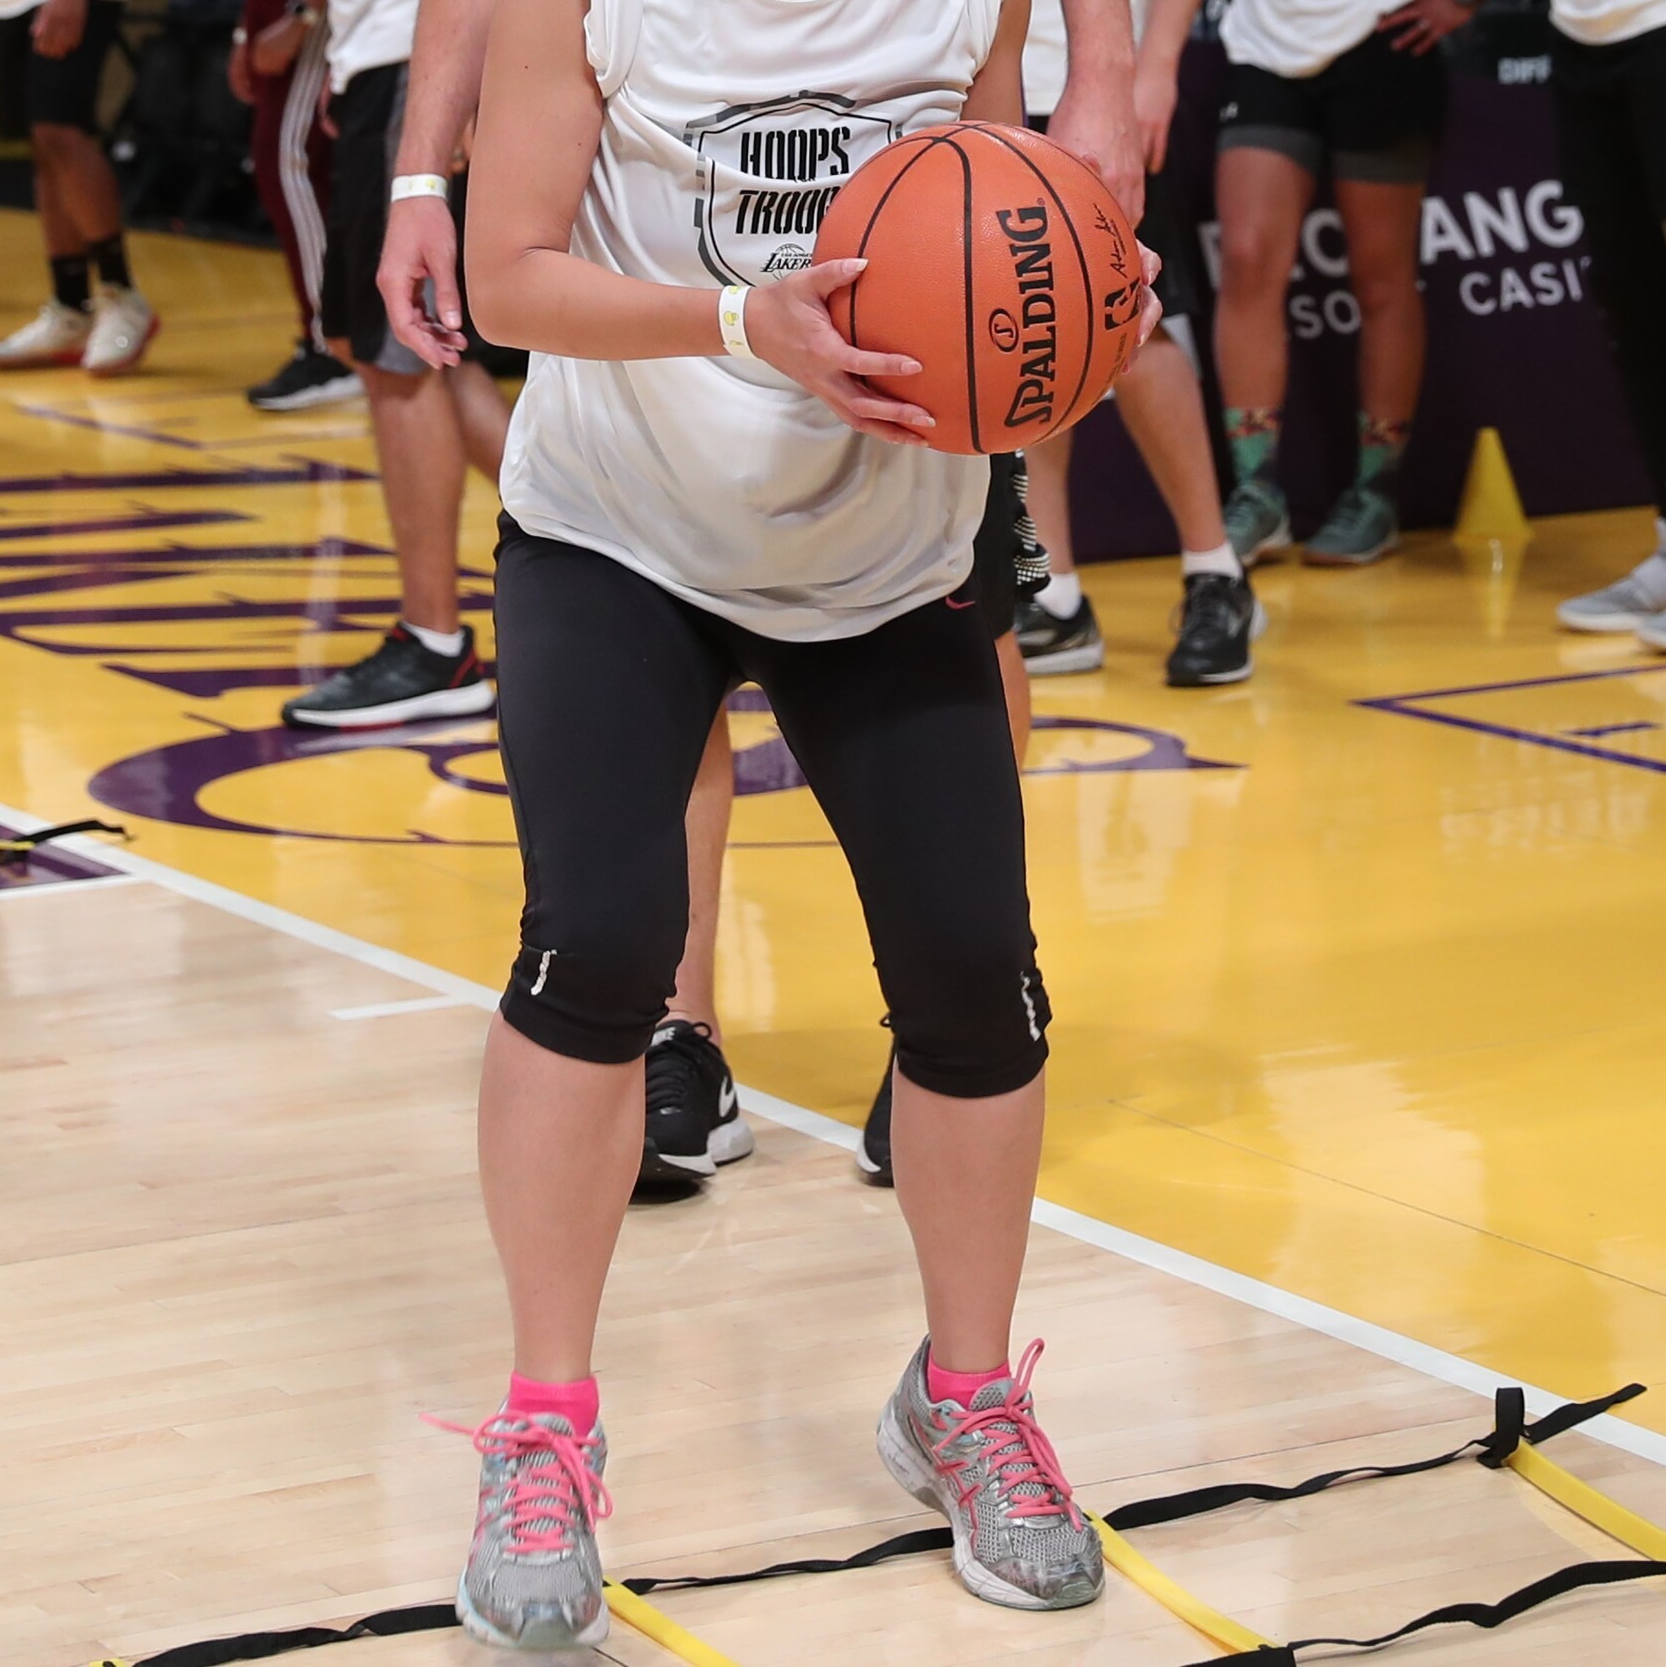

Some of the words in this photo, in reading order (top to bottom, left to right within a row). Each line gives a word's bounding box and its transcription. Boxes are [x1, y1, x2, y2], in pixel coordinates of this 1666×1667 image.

[740, 126, 851, 181] HOOPS
[735, 186, 842, 234] TROOP
[760, 253, 812, 272] LAKER
[1459, 259, 1591, 316] CASI
[996, 206, 1056, 428] SPALDING
